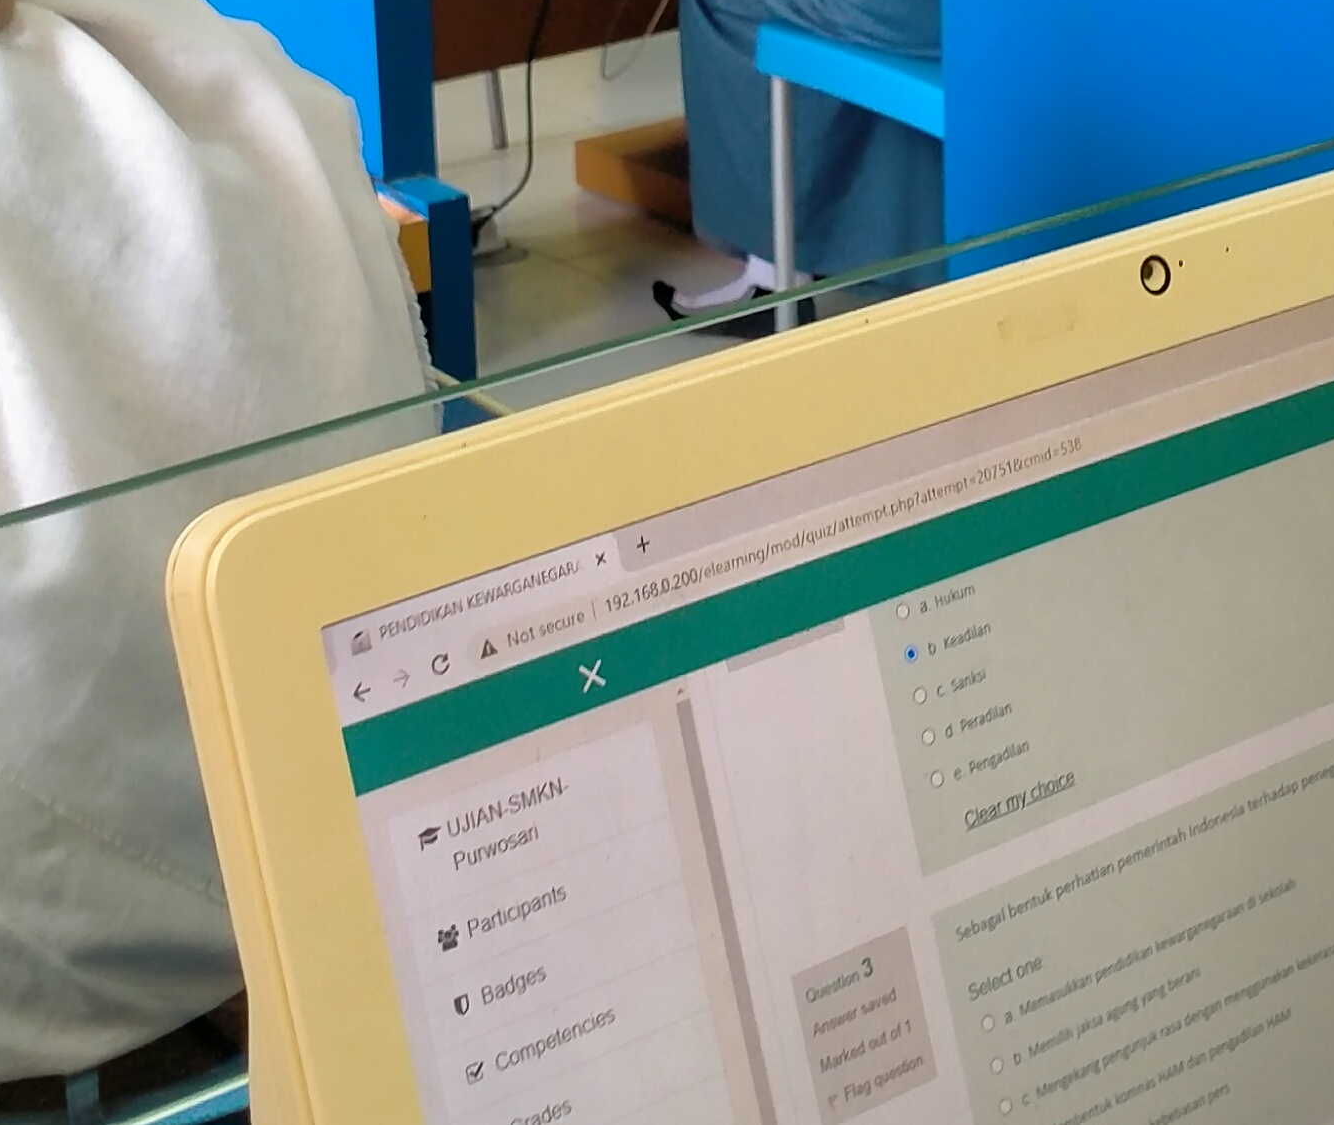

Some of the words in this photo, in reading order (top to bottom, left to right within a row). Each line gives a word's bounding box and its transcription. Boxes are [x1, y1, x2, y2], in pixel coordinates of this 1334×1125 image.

[934, 584, 976, 608] Hukum
[379, 598, 463, 642] PENDIDIKAN
[507, 626, 535, 648] Not
[538, 609, 586, 638] secure
[943, 622, 992, 650] Keadilan
[960, 702, 1013, 732] Peradilan
[968, 740, 1030, 773] Pengadilan
[446, 776, 570, 838] UJIAN-SMKN-
[964, 800, 1003, 831] Clear
[1006, 789, 1027, 811] my
[1030, 771, 1077, 803] choice
[453, 822, 540, 871] Purwosari
[955, 906, 1006, 943] Sebagai
[1007, 887, 1054, 920] bentuk
[1055, 861, 1115, 901] perhatian
[1117, 827, 1187, 874] pemerintah
[1188, 803, 1246, 839] Indonesia
[1247, 781, 1299, 813] terhadap
[466, 884, 568, 939] Participants
[481, 964, 548, 1006] Badges
[805, 971, 860, 1004] Question
[861, 957, 874, 978] 3
[968, 966, 1014, 1002] Select
[1094, 945, 1153, 985] pendidikan
[813, 1007, 858, 1039] Answer
[860, 986, 897, 1016] saved
[495, 1007, 617, 1072] Competencies
[819, 1040, 866, 1074] Marked
[868, 1030, 888, 1051] out
[890, 1021, 902, 1042] of
[904, 1018, 912, 1034] 1
[843, 1080, 872, 1102] Flag
[874, 1055, 925, 1089] question
